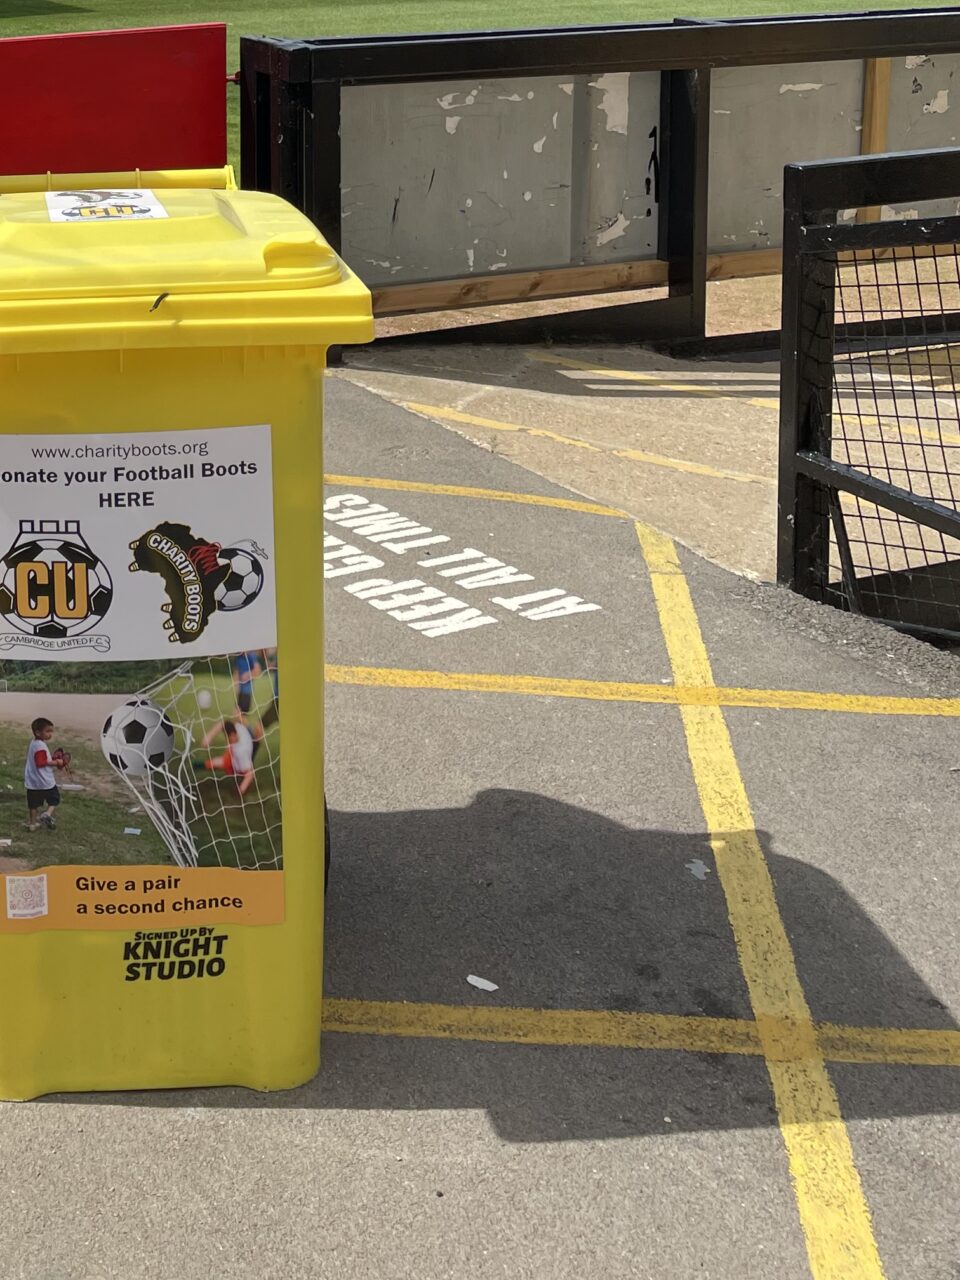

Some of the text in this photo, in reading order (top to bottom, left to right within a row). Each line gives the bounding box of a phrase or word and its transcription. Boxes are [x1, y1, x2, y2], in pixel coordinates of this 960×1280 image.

[31, 441, 209, 460] www.charityboots.org
[64, 469, 107, 486] your
[113, 464, 194, 482] Football
[201, 460, 258, 478] Boots
[99, 491, 155, 508] HERE
[323, 493, 452, 555] TIMES
[417, 547, 536, 590] ALL
[14, 561, 89, 620] CU
[147, 532, 204, 632] CHARITY BOOTS
[343, 579, 499, 638] KEEP
[489, 588, 603, 621] AT
[4, 635, 56, 648] CAMBRIDGE
[56, 638, 88, 648] UNITED
[75, 876, 181, 894] Give a pair
[76, 896, 243, 915] a second chance
[123, 935, 228, 960] KNIGHT
[125, 957, 226, 981] STUDIO
